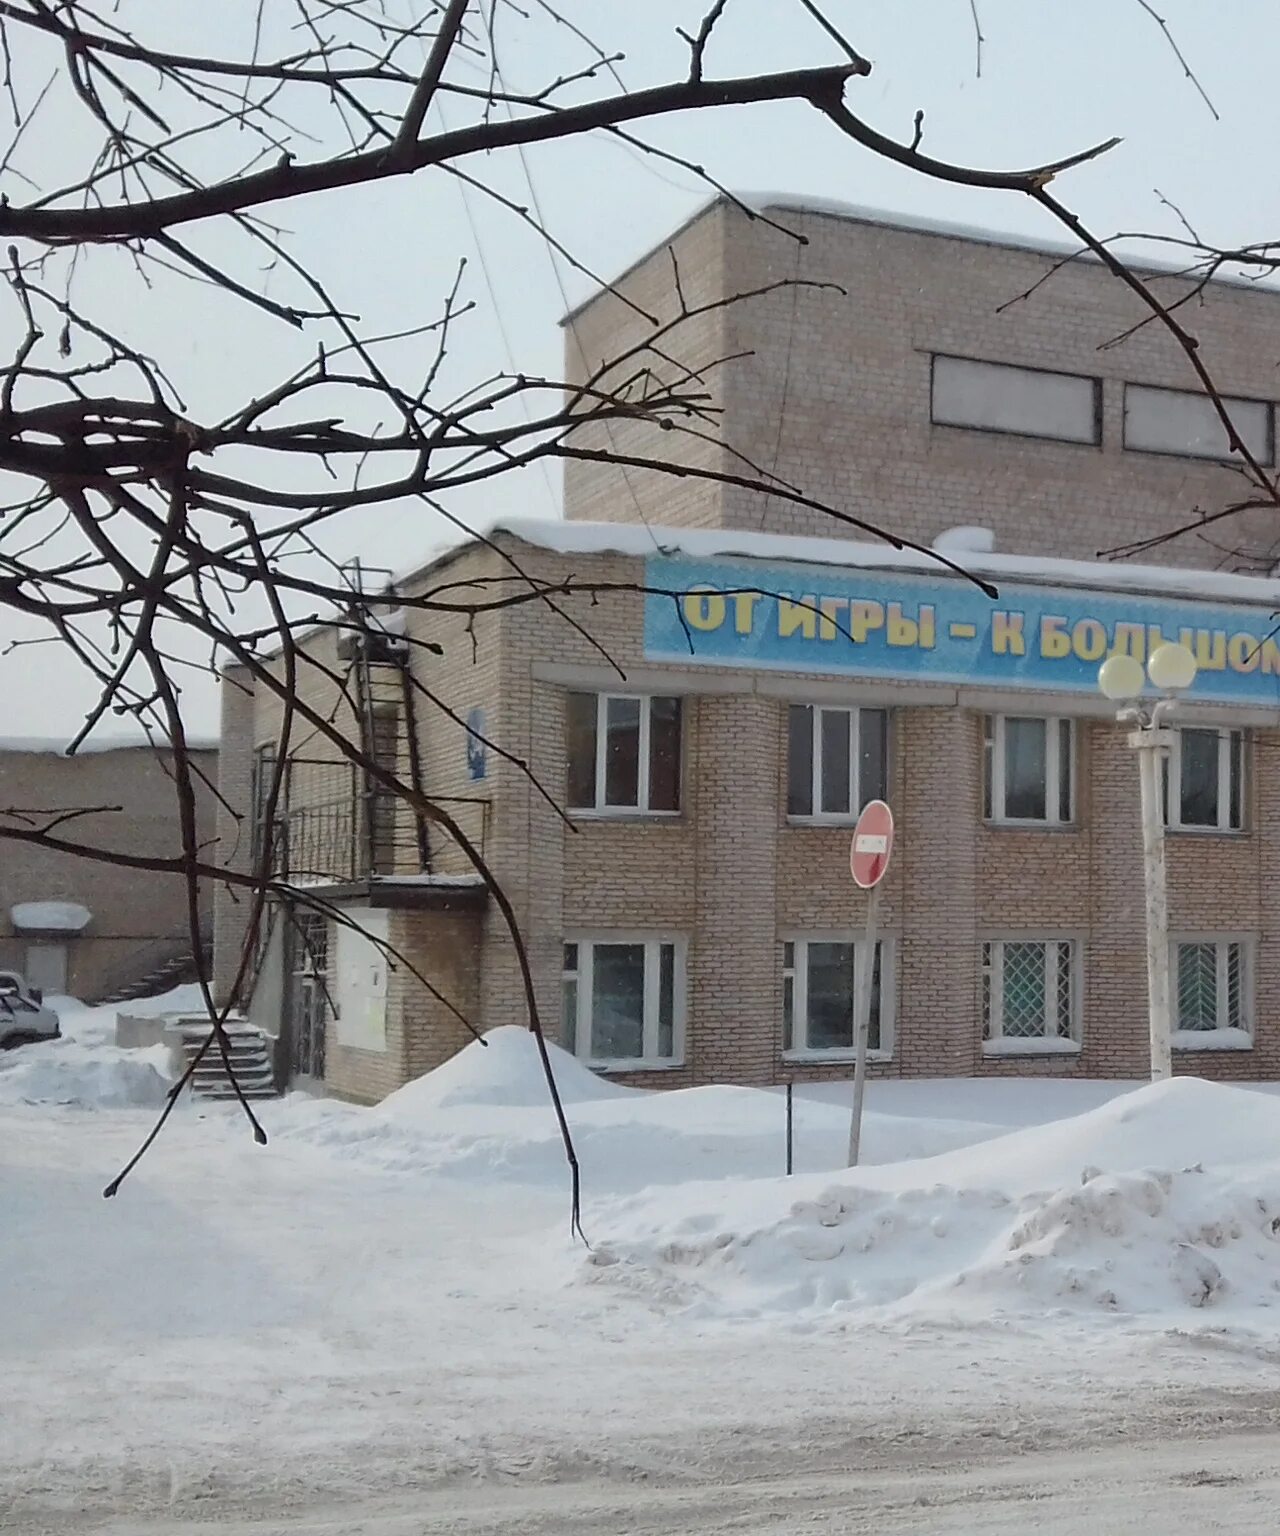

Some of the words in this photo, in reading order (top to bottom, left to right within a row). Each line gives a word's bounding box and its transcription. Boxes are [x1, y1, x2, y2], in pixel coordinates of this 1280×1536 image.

[683, 582, 761, 634] ОТ
[777, 591, 935, 648] ИГРЫ
[991, 609, 1025, 656] К
